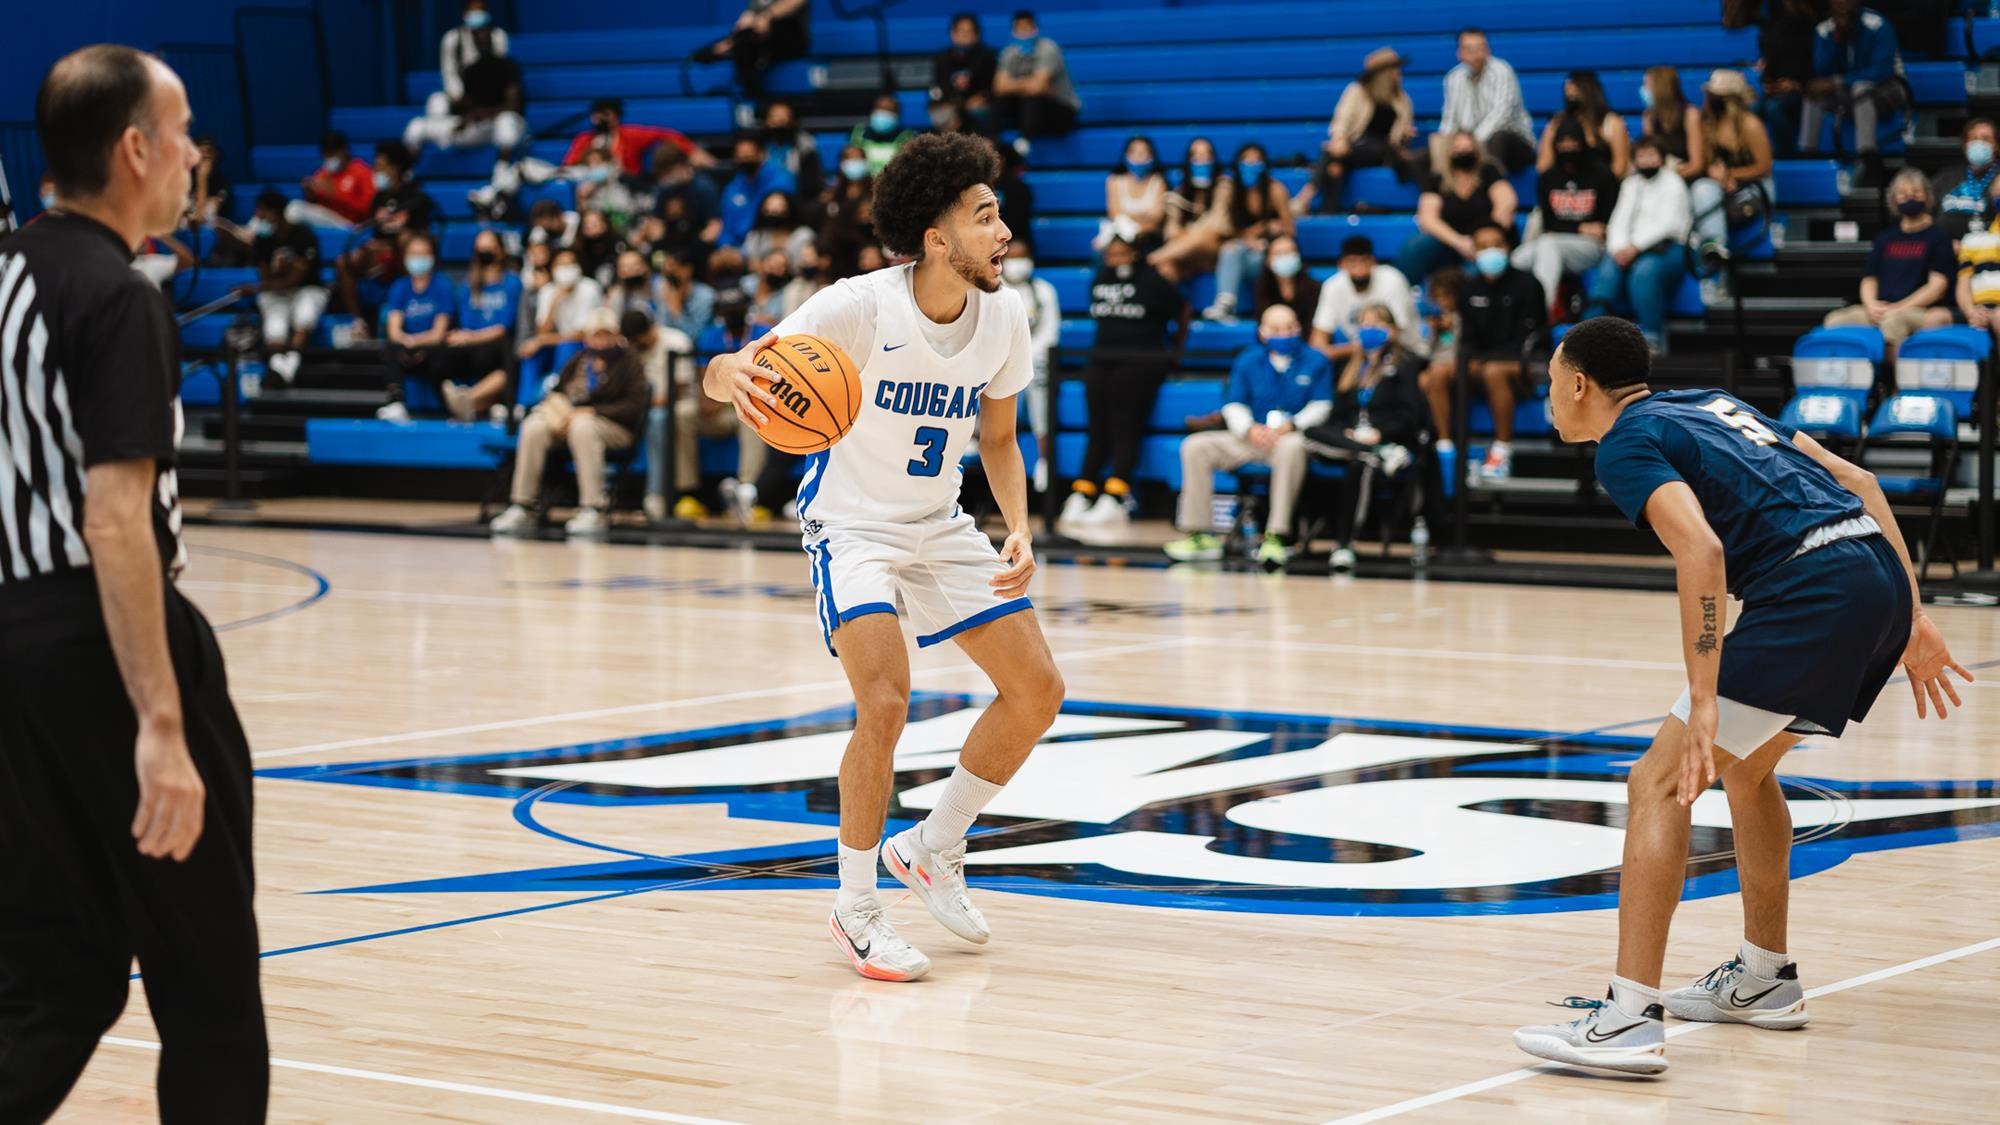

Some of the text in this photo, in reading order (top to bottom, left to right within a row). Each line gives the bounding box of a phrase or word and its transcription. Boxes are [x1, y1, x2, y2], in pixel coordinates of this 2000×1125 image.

[757, 355, 811, 419] Wilon
[906, 425, 949, 477] 3
[1695, 397, 1779, 447] 5
[1693, 594, 1719, 659] Beast
